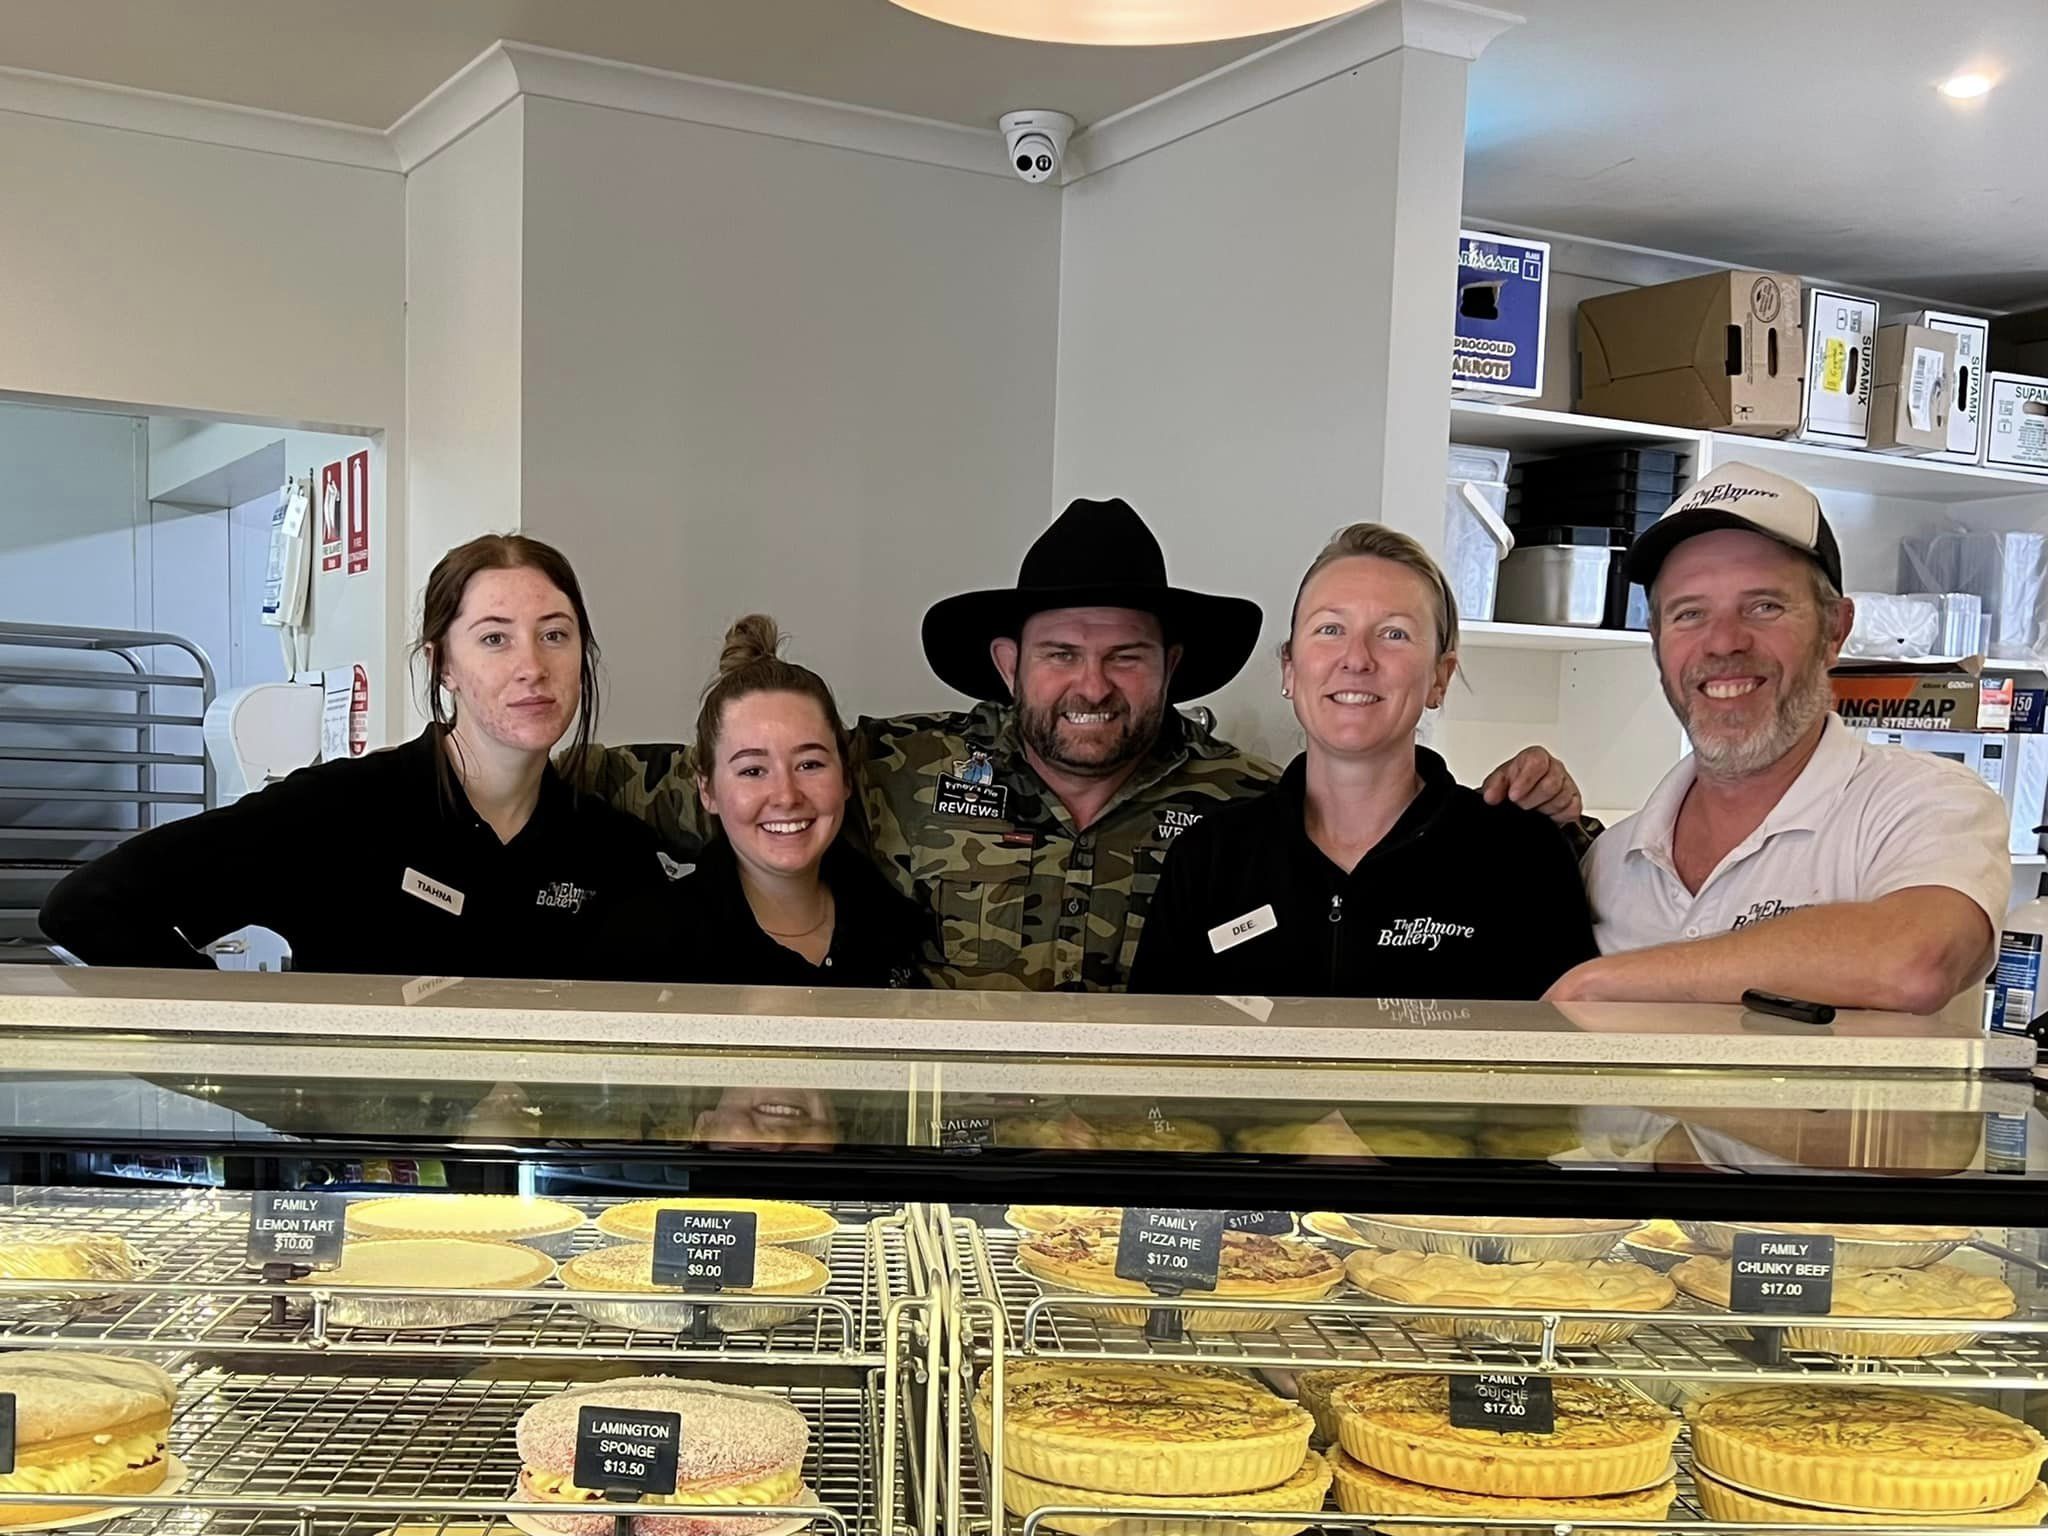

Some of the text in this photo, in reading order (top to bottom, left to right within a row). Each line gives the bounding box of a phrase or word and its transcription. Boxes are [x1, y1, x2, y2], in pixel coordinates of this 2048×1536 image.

[1857, 335, 1872, 406] SUPAMIX
[1968, 356, 1980, 424] SUPAMIX
[1710, 483, 1780, 501] Elmore
[2012, 696, 2033, 711] 150
[1881, 717, 1951, 729] STRENGTH
[938, 801, 1000, 818] REVIEWS
[1232, 919, 1258, 937] DEE
[1410, 916, 1476, 939] Elmore
[1376, 928, 1442, 952] Bakery
[273, 1198, 319, 1212] FAMILY
[255, 1218, 335, 1232] LEMON TART
[683, 1216, 732, 1230] FAMILY
[1150, 1214, 1198, 1232] FAMILY
[1229, 1211, 1265, 1229] $17.00
[274, 1237, 314, 1252] $10.00
[672, 1231, 737, 1246] CUSTARD
[1139, 1231, 1201, 1251] PIZZA PIE
[686, 1247, 722, 1261] TART
[1760, 1243, 1809, 1256] FAMILY
[1146, 1252, 1189, 1269] $17.00
[687, 1263, 722, 1277] $9.00
[1737, 1261, 1831, 1277] CHUNKY BEEF
[1760, 1282, 1803, 1296] $17.00
[1479, 1373, 1528, 1386] FAMILY
[1483, 1401, 1526, 1416] $17.00
[591, 1420, 670, 1439] LAMINGTON
[599, 1439, 657, 1459] SPONGE
[603, 1459, 646, 1476] $13.50
